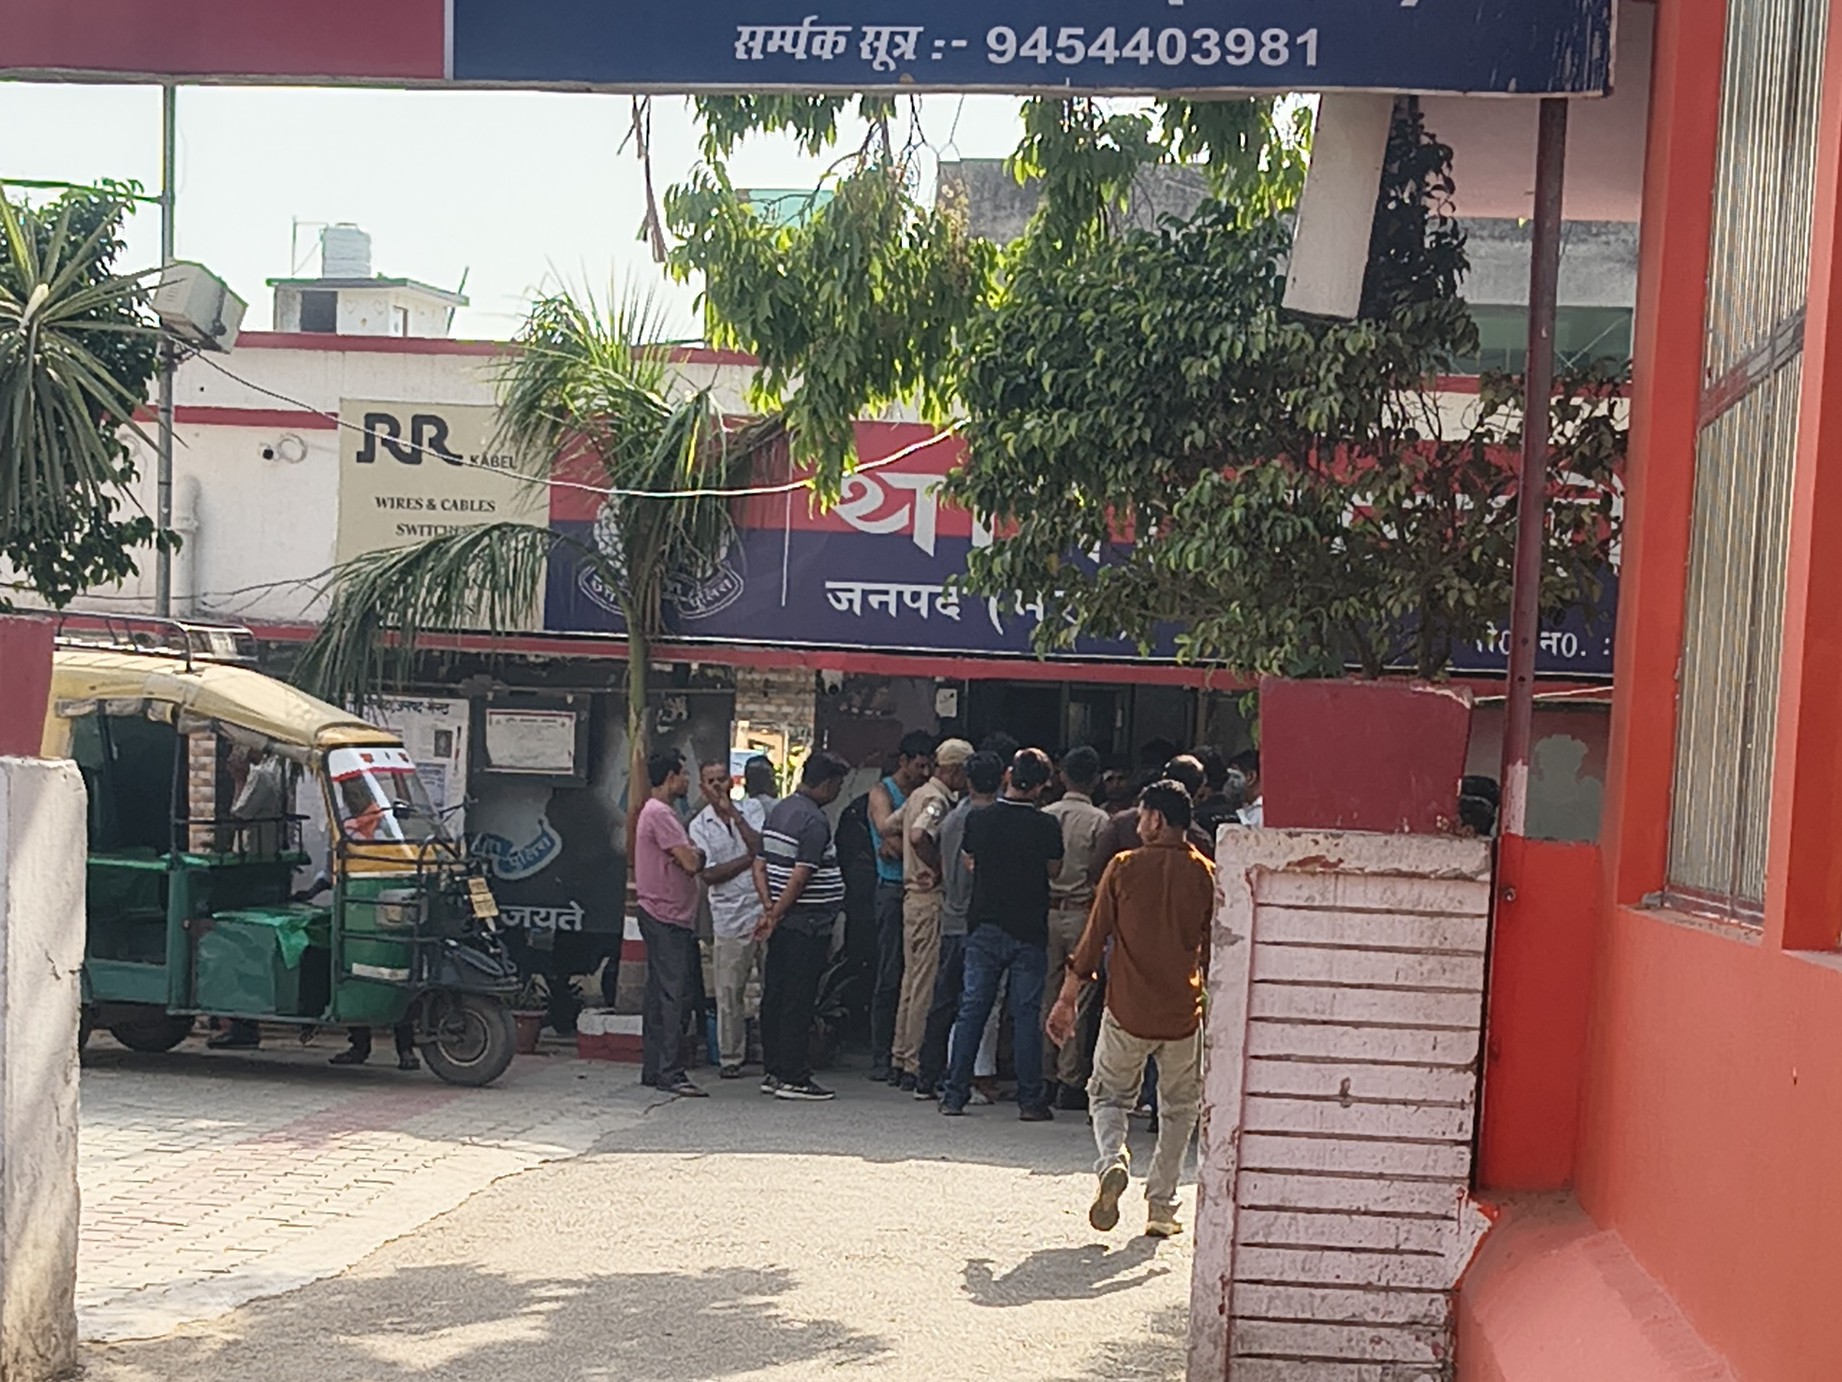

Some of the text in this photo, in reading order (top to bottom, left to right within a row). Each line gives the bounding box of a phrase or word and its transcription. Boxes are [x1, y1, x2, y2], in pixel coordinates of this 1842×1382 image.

[859, 26, 924, 71] सूत्र
[986, 26, 1320, 66] 9454403981
[469, 454, 518, 470] KABEL
[375, 496, 496, 513] WIRES & CABLES
[824, 580, 961, 622] जनपद
[498, 900, 585, 932] जयते
